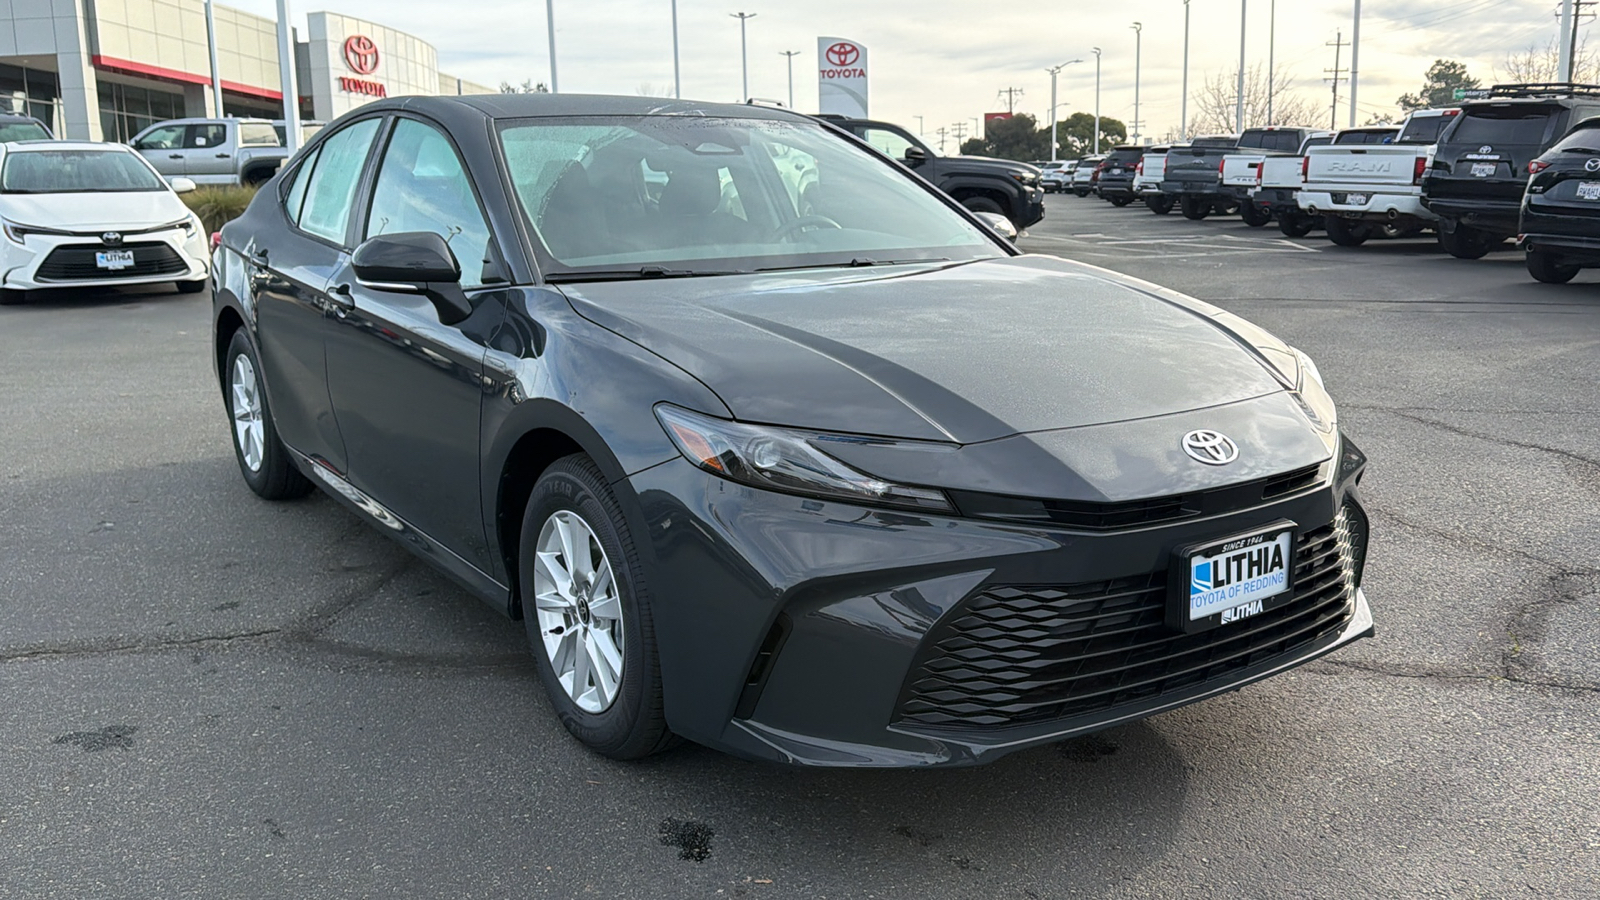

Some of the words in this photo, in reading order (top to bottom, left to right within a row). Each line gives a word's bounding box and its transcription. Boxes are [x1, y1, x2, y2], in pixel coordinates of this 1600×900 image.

[820, 68, 866, 79] TOYOTA
[339, 77, 386, 98] TOYOTA
[1328, 162, 1391, 172] RAM
[106, 254, 132, 262] LITHIA
[1222, 539, 1244, 552] SINCE
[1247, 536, 1263, 546] 1946
[1213, 543, 1284, 589] LITHIA
[1190, 590, 1227, 609] TOYOTA
[1229, 586, 1240, 598] OF
[1244, 572, 1284, 595] REDDING
[1231, 600, 1263, 621] LITHIA
